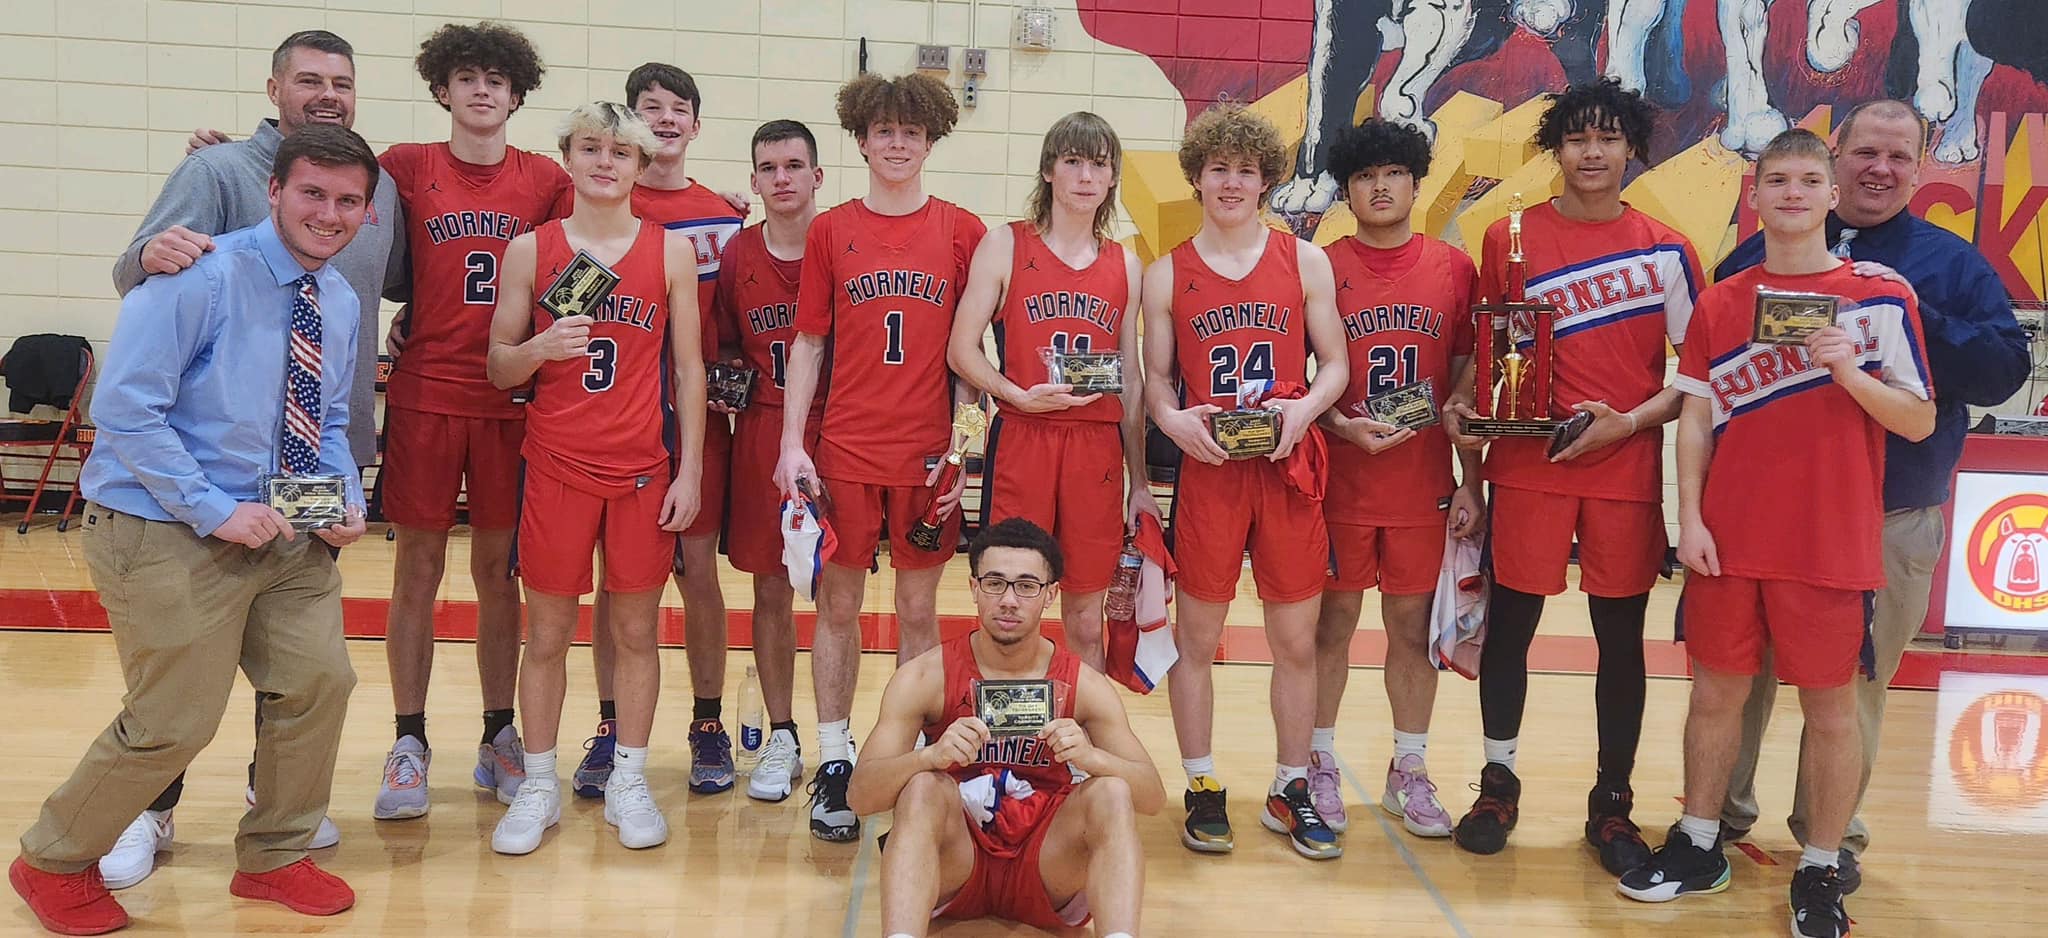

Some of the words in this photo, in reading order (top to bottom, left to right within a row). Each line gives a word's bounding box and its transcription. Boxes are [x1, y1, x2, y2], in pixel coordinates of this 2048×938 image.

[464, 251, 496, 304] 2
[844, 270, 948, 306] HORNELL
[884, 311, 904, 364] 1
[1024, 291, 1120, 335] HORNELL
[1190, 302, 1290, 341] HORNELL
[1343, 304, 1444, 342] HORNELL
[582, 337, 617, 392] 3
[1208, 341, 1276, 397] 24
[1367, 345, 1419, 398] 21
